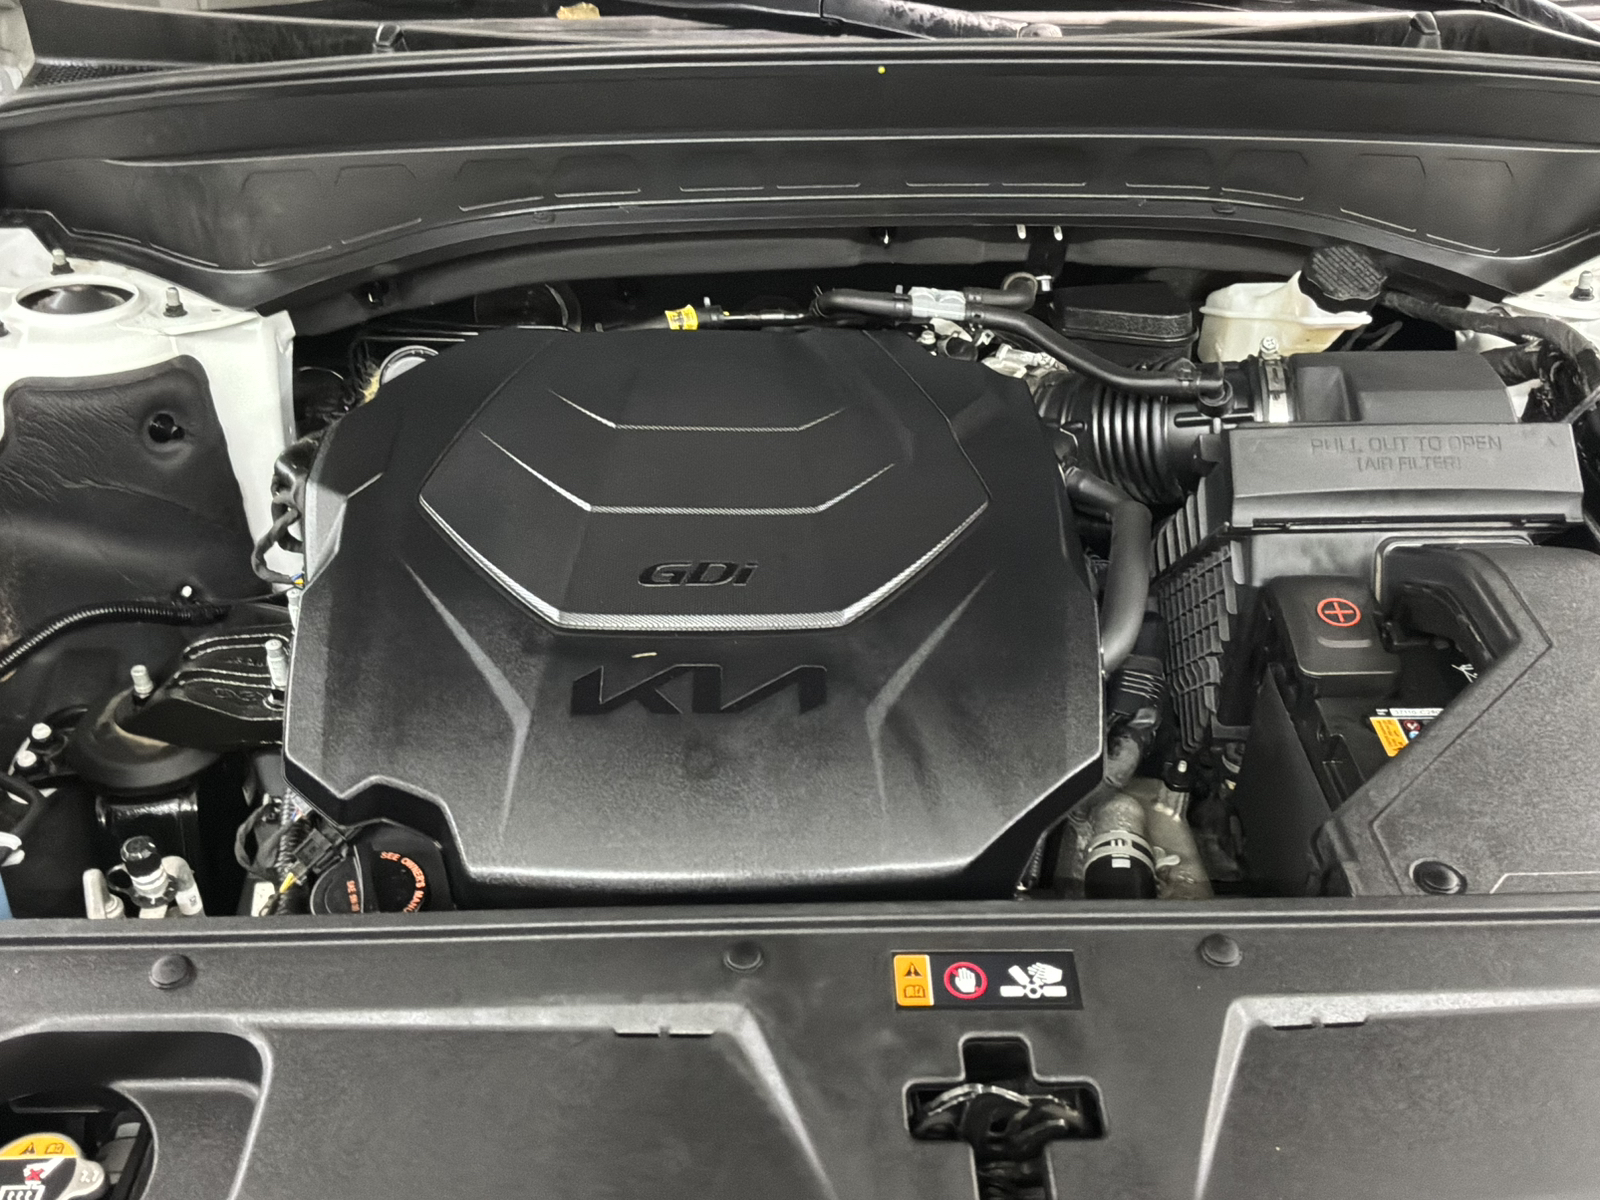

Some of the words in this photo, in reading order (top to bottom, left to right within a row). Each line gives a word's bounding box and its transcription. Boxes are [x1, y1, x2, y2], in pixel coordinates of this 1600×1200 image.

[1310, 436, 1363, 454] PULL
[1367, 435, 1409, 452] OUT
[1413, 435, 1442, 452] TO
[1447, 434, 1503, 452] OPEN
[637, 560, 760, 588] GDi
[569, 664, 828, 717] KIA
[380, 851, 401, 862] SEE
